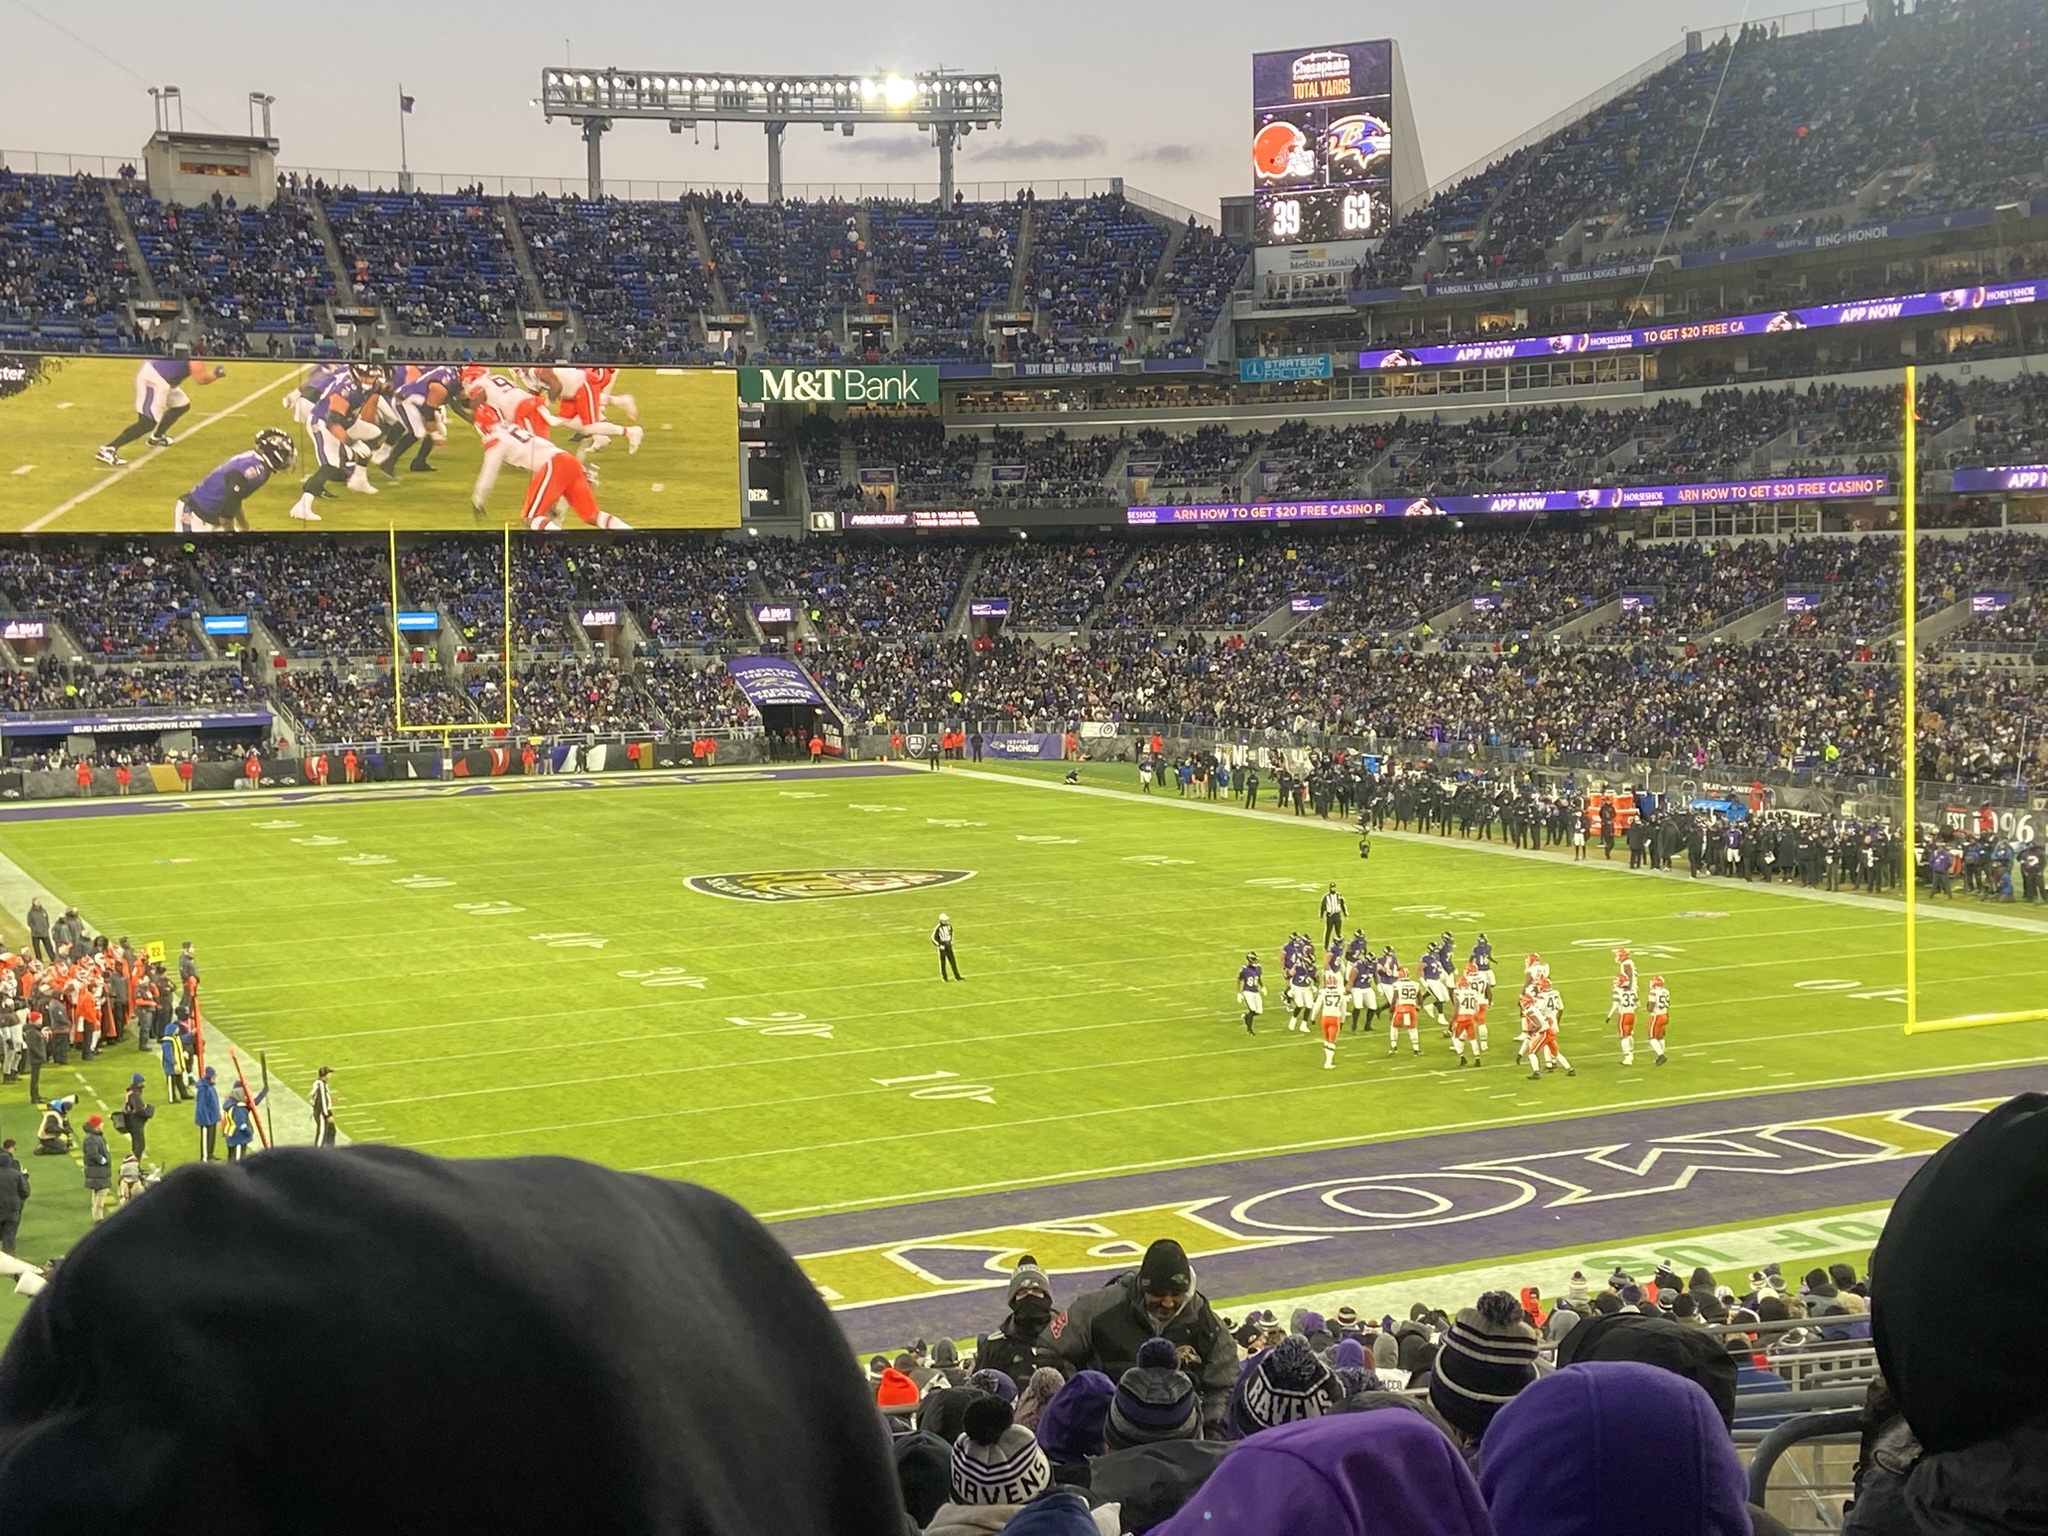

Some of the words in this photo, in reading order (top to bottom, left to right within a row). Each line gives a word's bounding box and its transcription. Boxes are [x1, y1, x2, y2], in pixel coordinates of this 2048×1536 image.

[1293, 58, 1350, 74] Chesapeake
[1293, 81, 1319, 99] TOTAL
[1321, 78, 1350, 97] YARDS
[1273, 200, 1299, 235] 39
[1344, 193, 1370, 230] 63
[1816, 232, 1841, 247] RING
[1848, 226, 1888, 242] HONOR
[1290, 259, 1325, 270] MedStar
[1328, 257, 1357, 267] Health
[1561, 271, 1592, 282] TERRELL
[1593, 267, 1617, 279] SUGGS
[1436, 283, 1472, 295] MARSHAL
[1474, 282, 1499, 293] YANDA
[1500, 277, 1539, 289] 2007-2019
[1840, 308, 1866, 323] APP
[1867, 303, 1902, 319] NOW
[1590, 334, 1633, 345] HORSESHOE
[1643, 331, 1657, 342] TO
[1660, 328, 1679, 341] GET
[1681, 326, 1700, 340] $20
[1702, 323, 1728, 336] FREE
[1456, 348, 1484, 361] APP
[1486, 345, 1516, 359] NOW
[1025, 364, 1040, 374] TEXT
[1041, 363, 1054, 374] FOR
[1055, 363, 1070, 373] HELP
[1264, 356, 1325, 369] STRATEGIC
[1265, 366, 1324, 379] FACTORY
[759, 369, 841, 400] M&T
[845, 369, 920, 400] Bank
[2008, 472, 2039, 488] APP
[1624, 493, 1663, 501] HORSESHOE
[1702, 488, 1730, 499] HOW
[1731, 486, 1747, 498] TO
[1749, 485, 1771, 497] GET
[1774, 483, 1794, 497] $20
[1798, 482, 1825, 495] FREE
[1828, 480, 1873, 493] CASINO
[1200, 508, 1229, 519] HOW
[1232, 507, 1248, 518] TO
[1251, 506, 1272, 517] GET
[1275, 505, 1297, 517] $20
[1301, 505, 1328, 516] FREE
[1330, 503, 1372, 515] CASINO
[1491, 499, 1516, 511] APP
[1518, 498, 1547, 510] NOW
[73, 725, 92, 734] BUD
[94, 724, 119, 733] LIGHT
[120, 722, 178, 732] TOUCHDOWN
[179, 721, 202, 729] CLUB
[1006, 744, 1039, 752] CHANGE
[1946, 812, 1966, 830] EST
[1325, 995, 1340, 1007] 57
[1402, 988, 1417, 999] 92
[1622, 993, 1636, 1007] 33
[1461, 997, 1475, 1009] 40
[870, 1070, 994, 1099] 10
